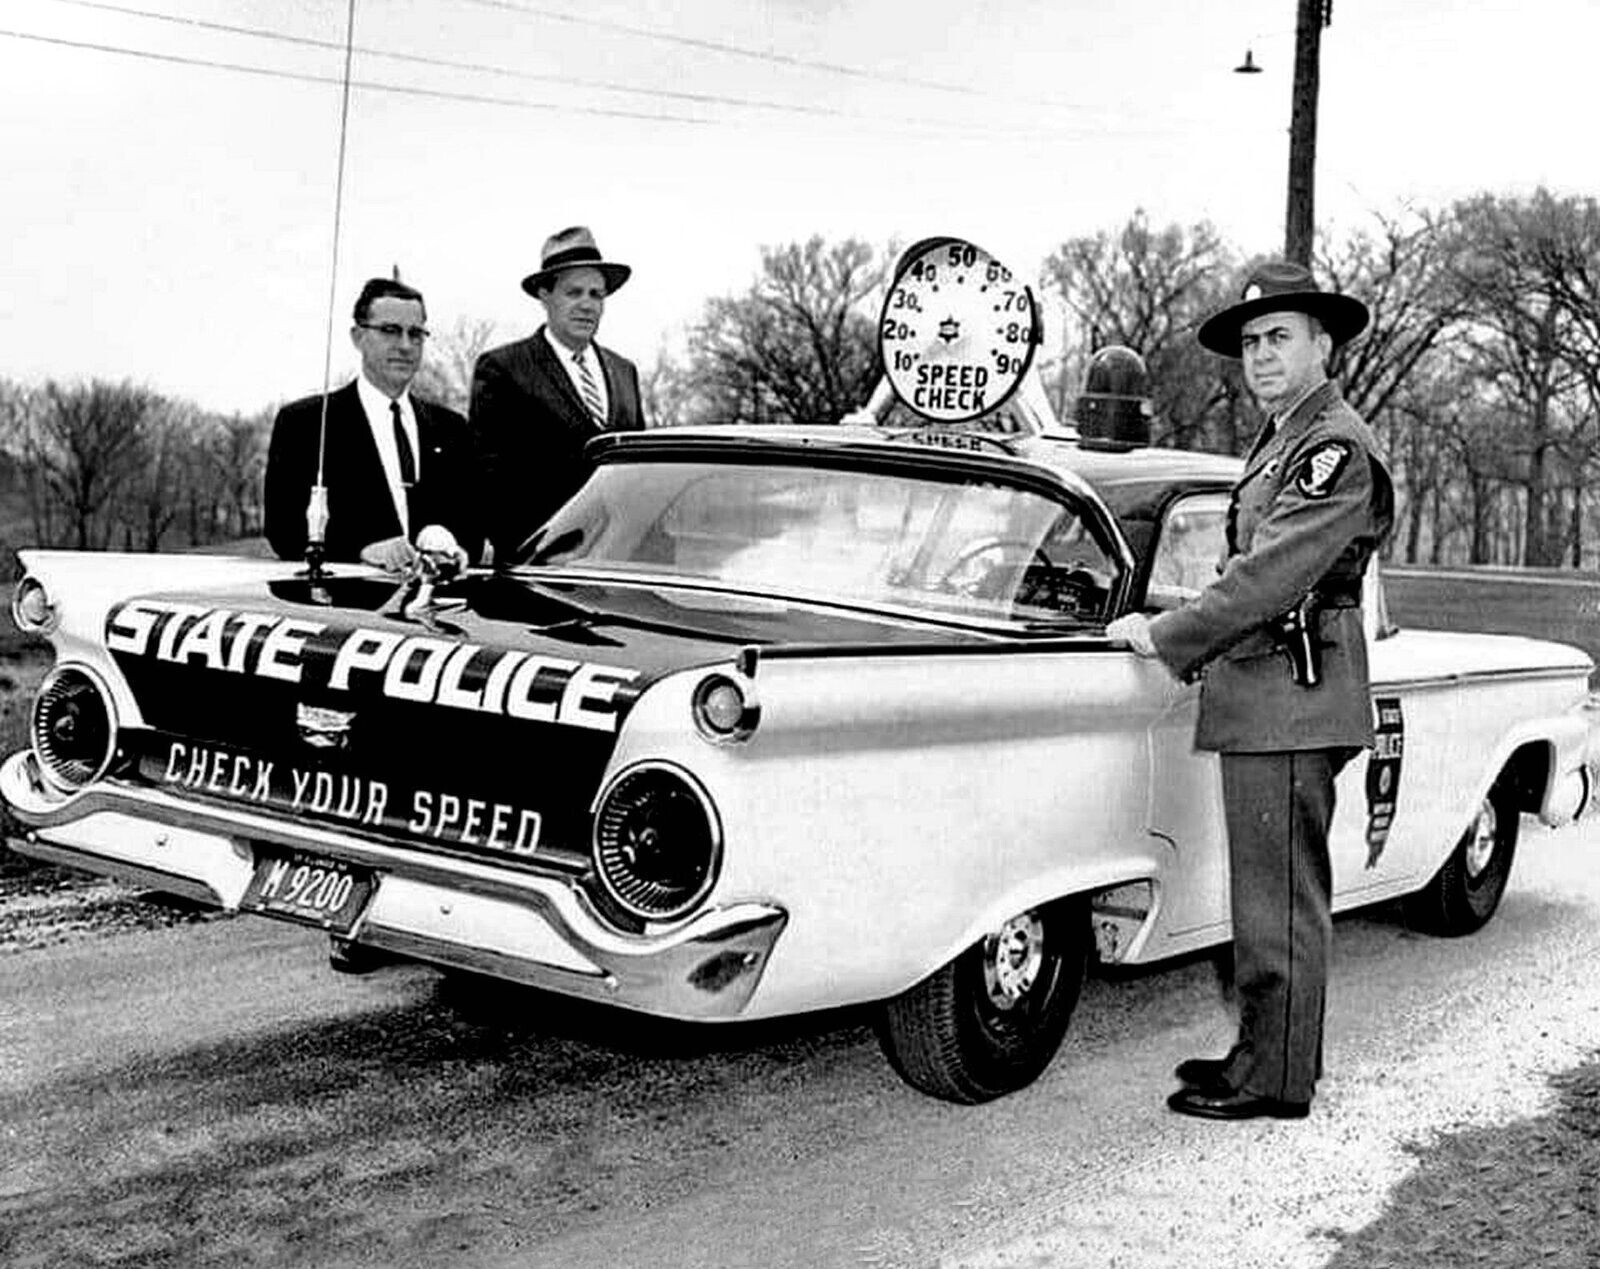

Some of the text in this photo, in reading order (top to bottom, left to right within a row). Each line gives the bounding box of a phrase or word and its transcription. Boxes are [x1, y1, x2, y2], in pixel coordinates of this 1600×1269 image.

[948, 245, 977, 267] 50
[911, 260, 936, 282] 40
[986, 260, 1012, 283] 60
[893, 288, 918, 310] 30
[1003, 290, 1028, 312] 70
[883, 318, 909, 340] 20
[1006, 322, 1031, 344] 80
[894, 350, 913, 372] 10
[996, 353, 1023, 375] 90
[917, 364, 988, 387] SPEED
[914, 387, 985, 411] CHECK
[108, 602, 640, 732] STATE POLICE
[165, 743, 542, 853] CHECK YOUR SPEED
[284, 865, 353, 913] 9200
